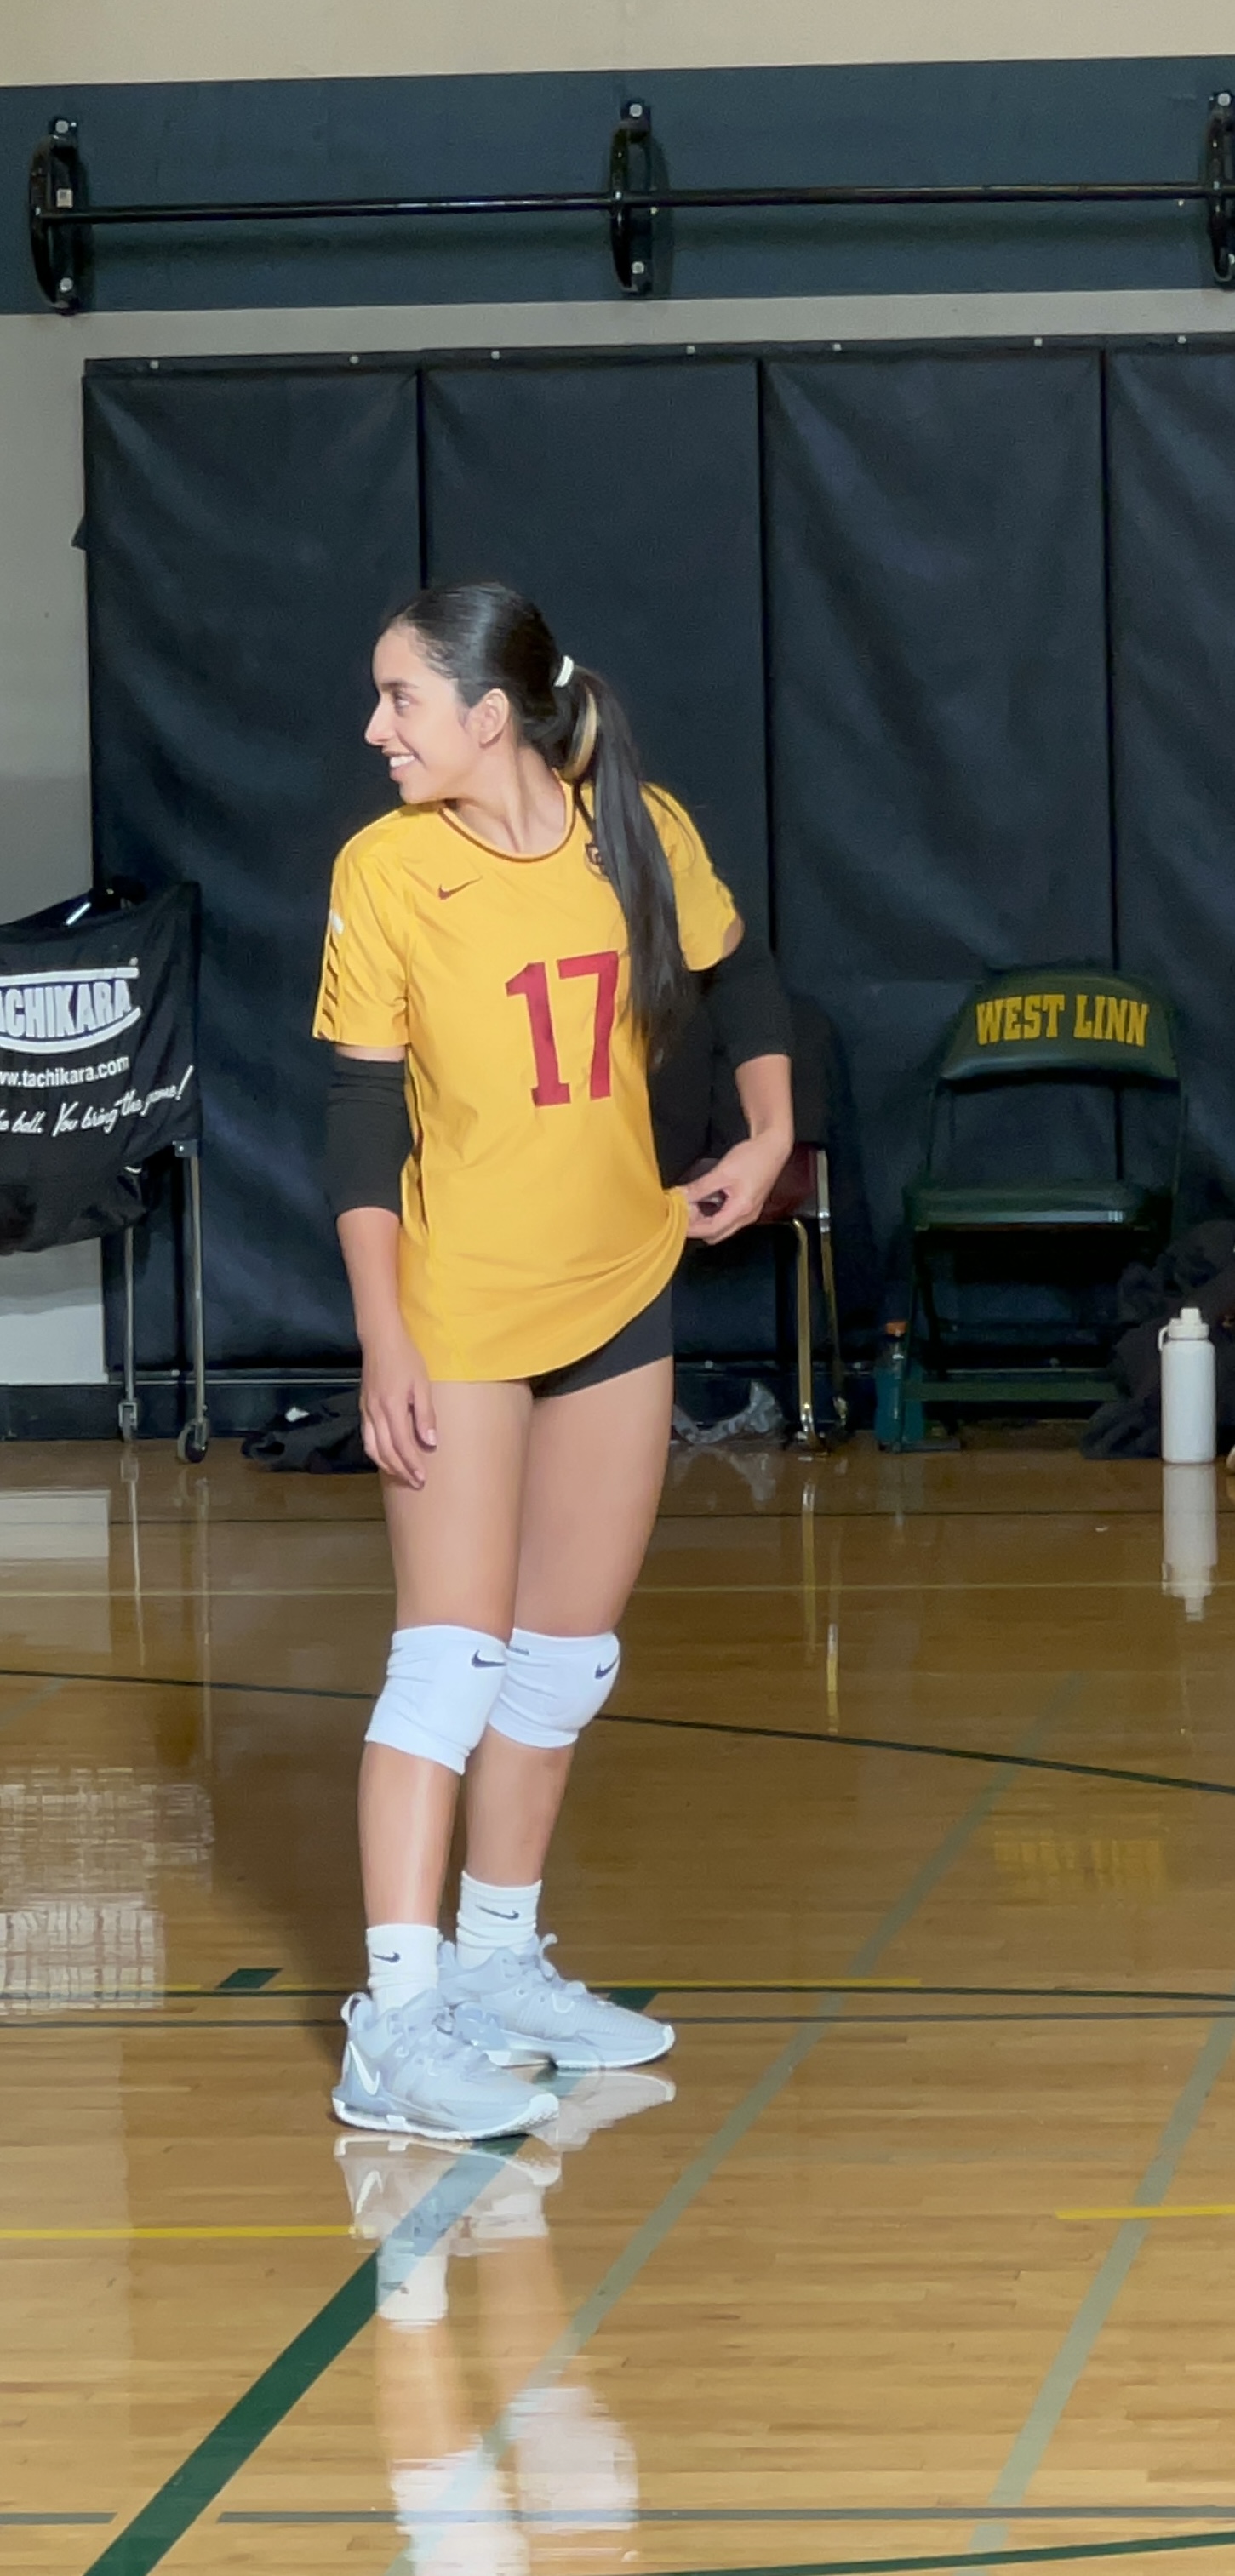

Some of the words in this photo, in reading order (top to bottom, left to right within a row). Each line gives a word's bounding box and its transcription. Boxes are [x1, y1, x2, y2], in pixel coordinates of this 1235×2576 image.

[505, 950, 619, 1108] 17
[976, 994, 1065, 1046] WEST
[1073, 994, 1148, 1047] LINN
[11, 1111, 46, 1134] ball.
[52, 1101, 79, 1137] You
[81, 1106, 118, 1134] bring
[114, 1089, 143, 1116] the
